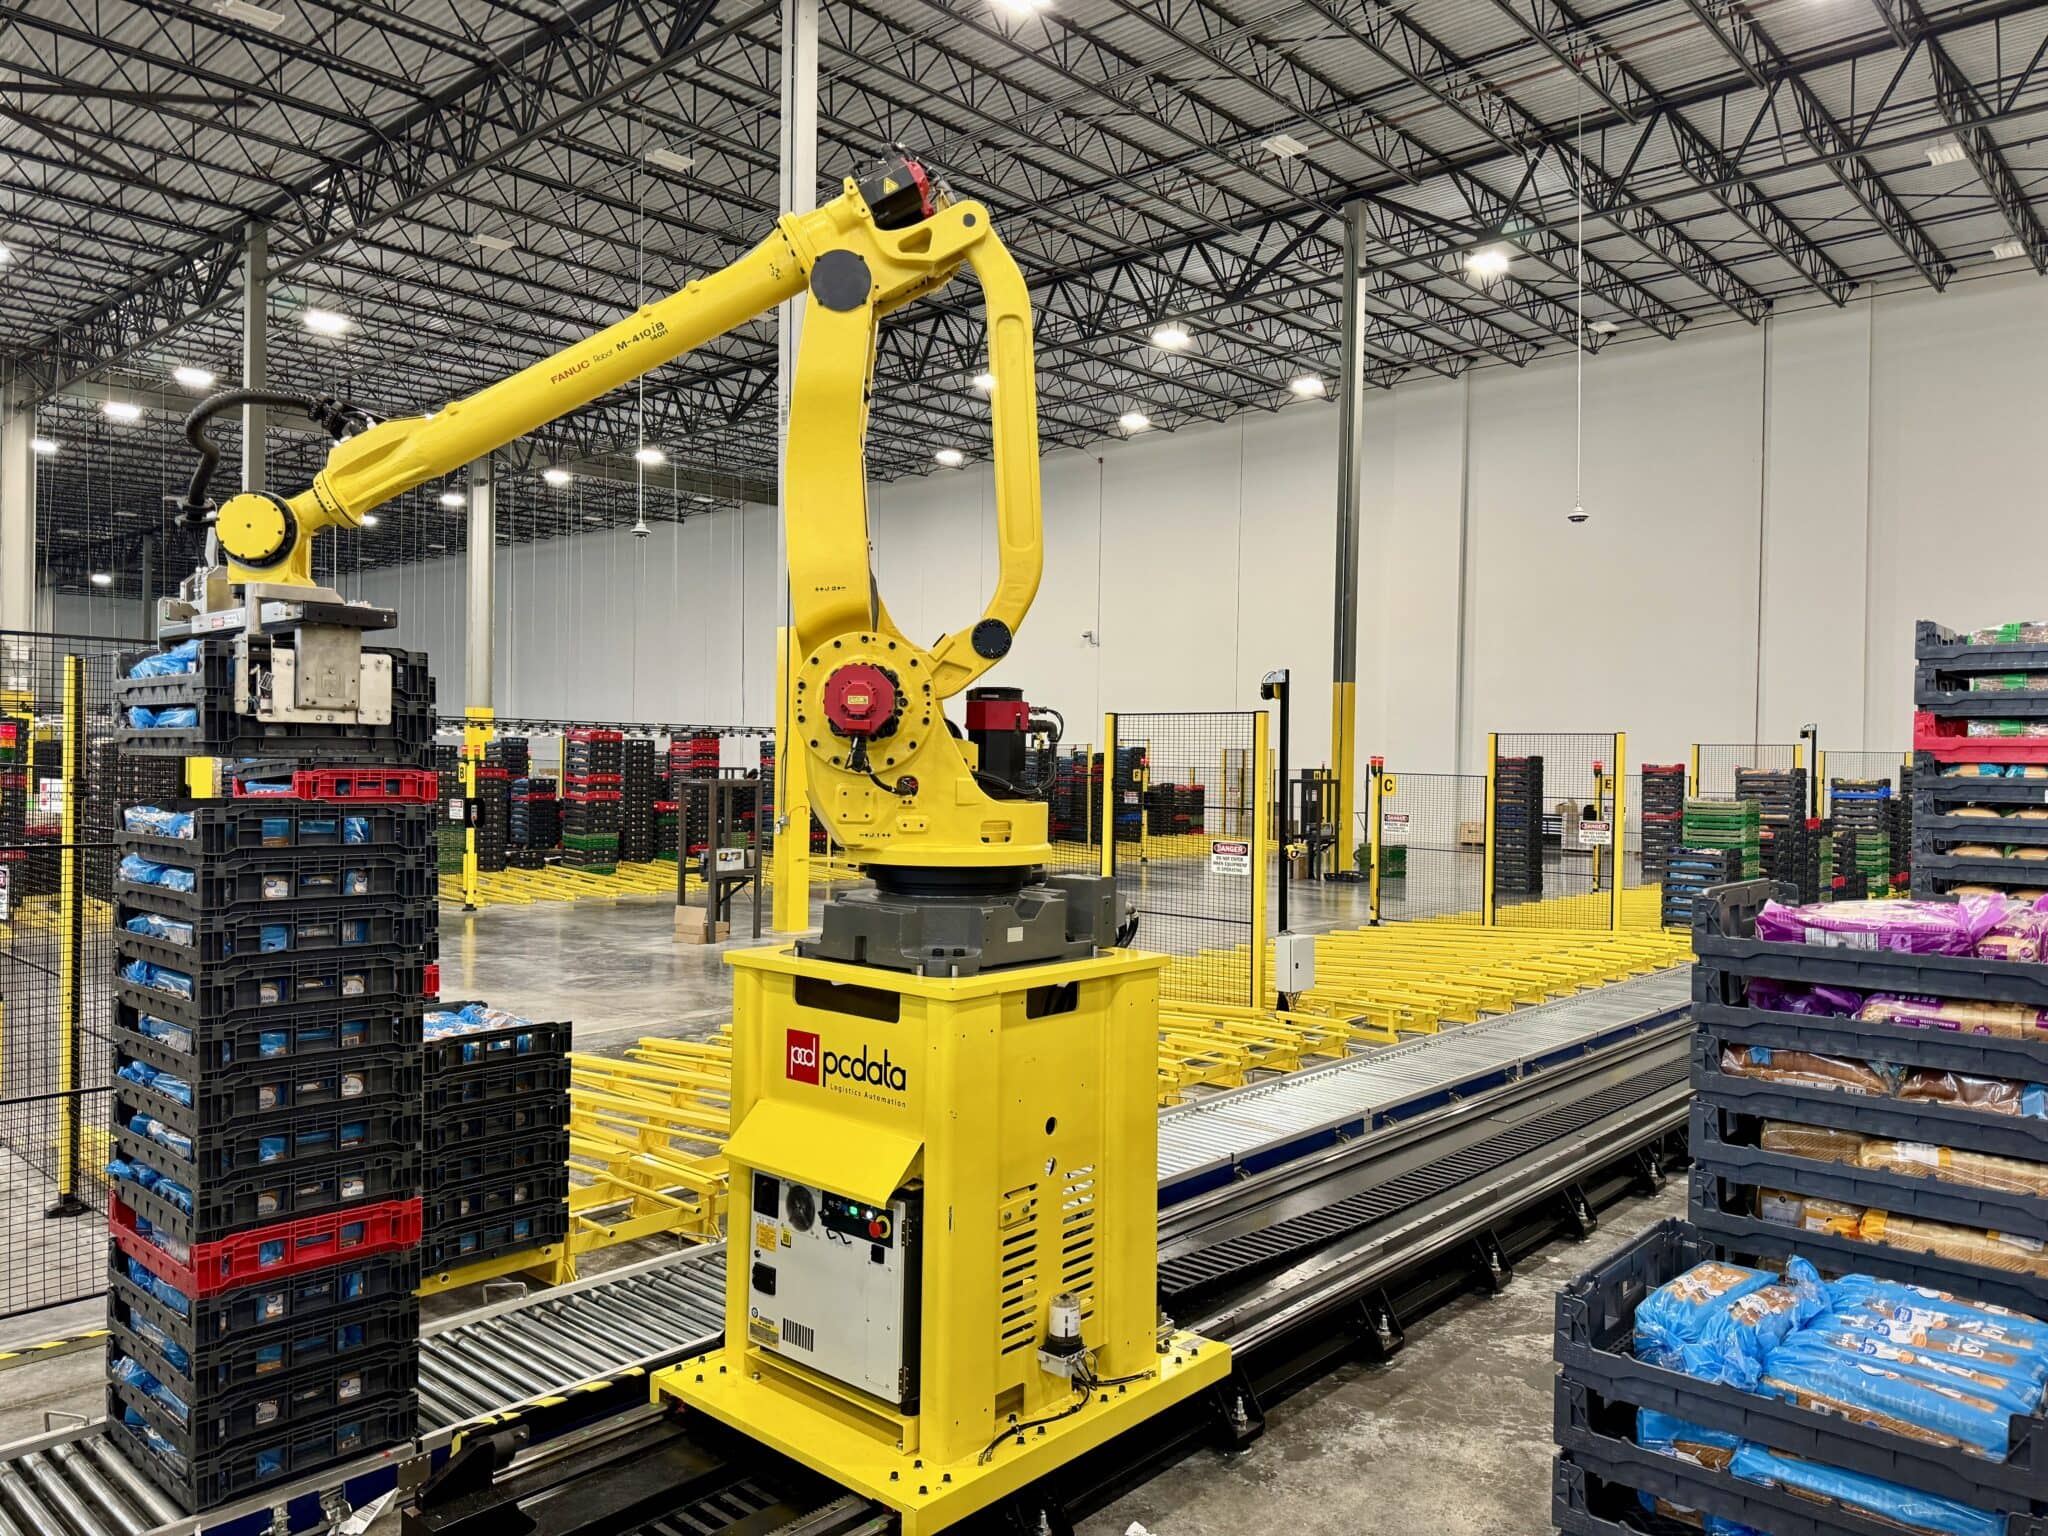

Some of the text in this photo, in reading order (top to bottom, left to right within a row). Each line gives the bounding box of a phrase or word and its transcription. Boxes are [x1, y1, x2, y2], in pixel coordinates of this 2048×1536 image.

[550, 359, 590, 385] FANUC
[592, 349, 614, 363] Robot
[1384, 779, 1393, 792] C
[1605, 779, 1612, 790] E
[1216, 843, 1243, 854] DANGER
[822, 1043, 907, 1092] pcdata
[829, 1082, 907, 1109] Logistics Automation
